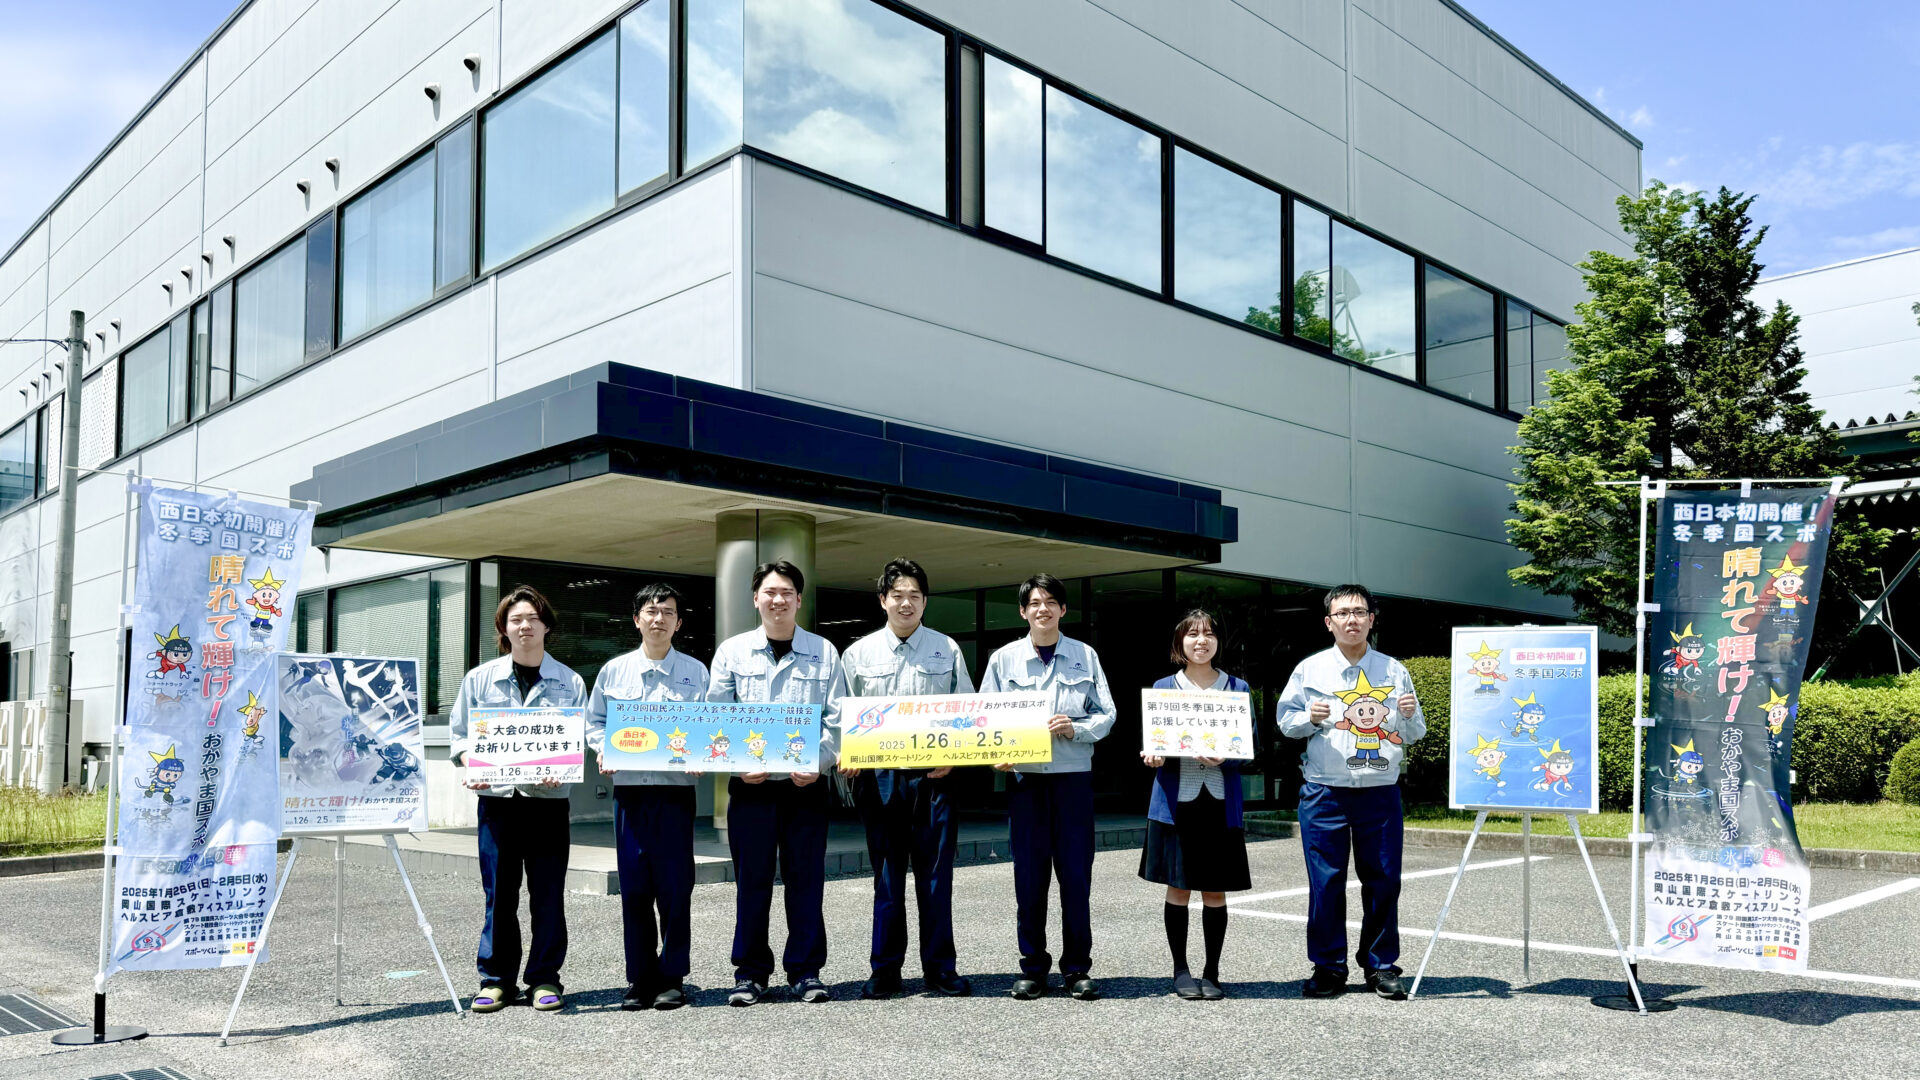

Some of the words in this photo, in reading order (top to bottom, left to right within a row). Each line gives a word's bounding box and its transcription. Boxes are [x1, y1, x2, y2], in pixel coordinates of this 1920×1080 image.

[159, 501, 298, 540] 西日本初開催！
[1673, 503, 1819, 523] 西日本初開催！
[158, 523, 294, 559] 冬季国スポ
[1672, 523, 1817, 543] 冬季国スポ
[202, 554, 245, 727] 晴れて輝け！
[1716, 546, 1763, 723] 晴れて輝け！
[1515, 651, 1583, 661] 西日本初開催！
[897, 700, 983, 716] 晴れて輝け！
[984, 700, 1046, 710] おかやま国スポ
[1147, 701, 1247, 714] 第79回冬季国スポを
[493, 725, 566, 736] 大会の成功を
[1151, 716, 1239, 728] 応援しています！
[474, 741, 581, 754] お祈りしています！
[879, 741, 906, 750] 2025
[910, 732, 949, 750] 1.26
[976, 731, 1004, 748] 2.5
[850, 753, 933, 764] 岡山国際スケートリンク
[942, 749, 1049, 760] ヘルスピア倉敷アイスアリーナ
[191, 732, 222, 849] おかやま国スポ
[400, 788, 419, 796] 2025
[1719, 727, 1744, 842] おかやま国スポ
[121, 886, 267, 911] 岡山国際スケートリンク
[1654, 883, 1801, 905] 岡山国際スケートリンク
[121, 899, 266, 923] ヘルスピア倉敷アイスアリーナ
[1654, 896, 1801, 917] ヘルスピア倉敷アイスアリーナ
